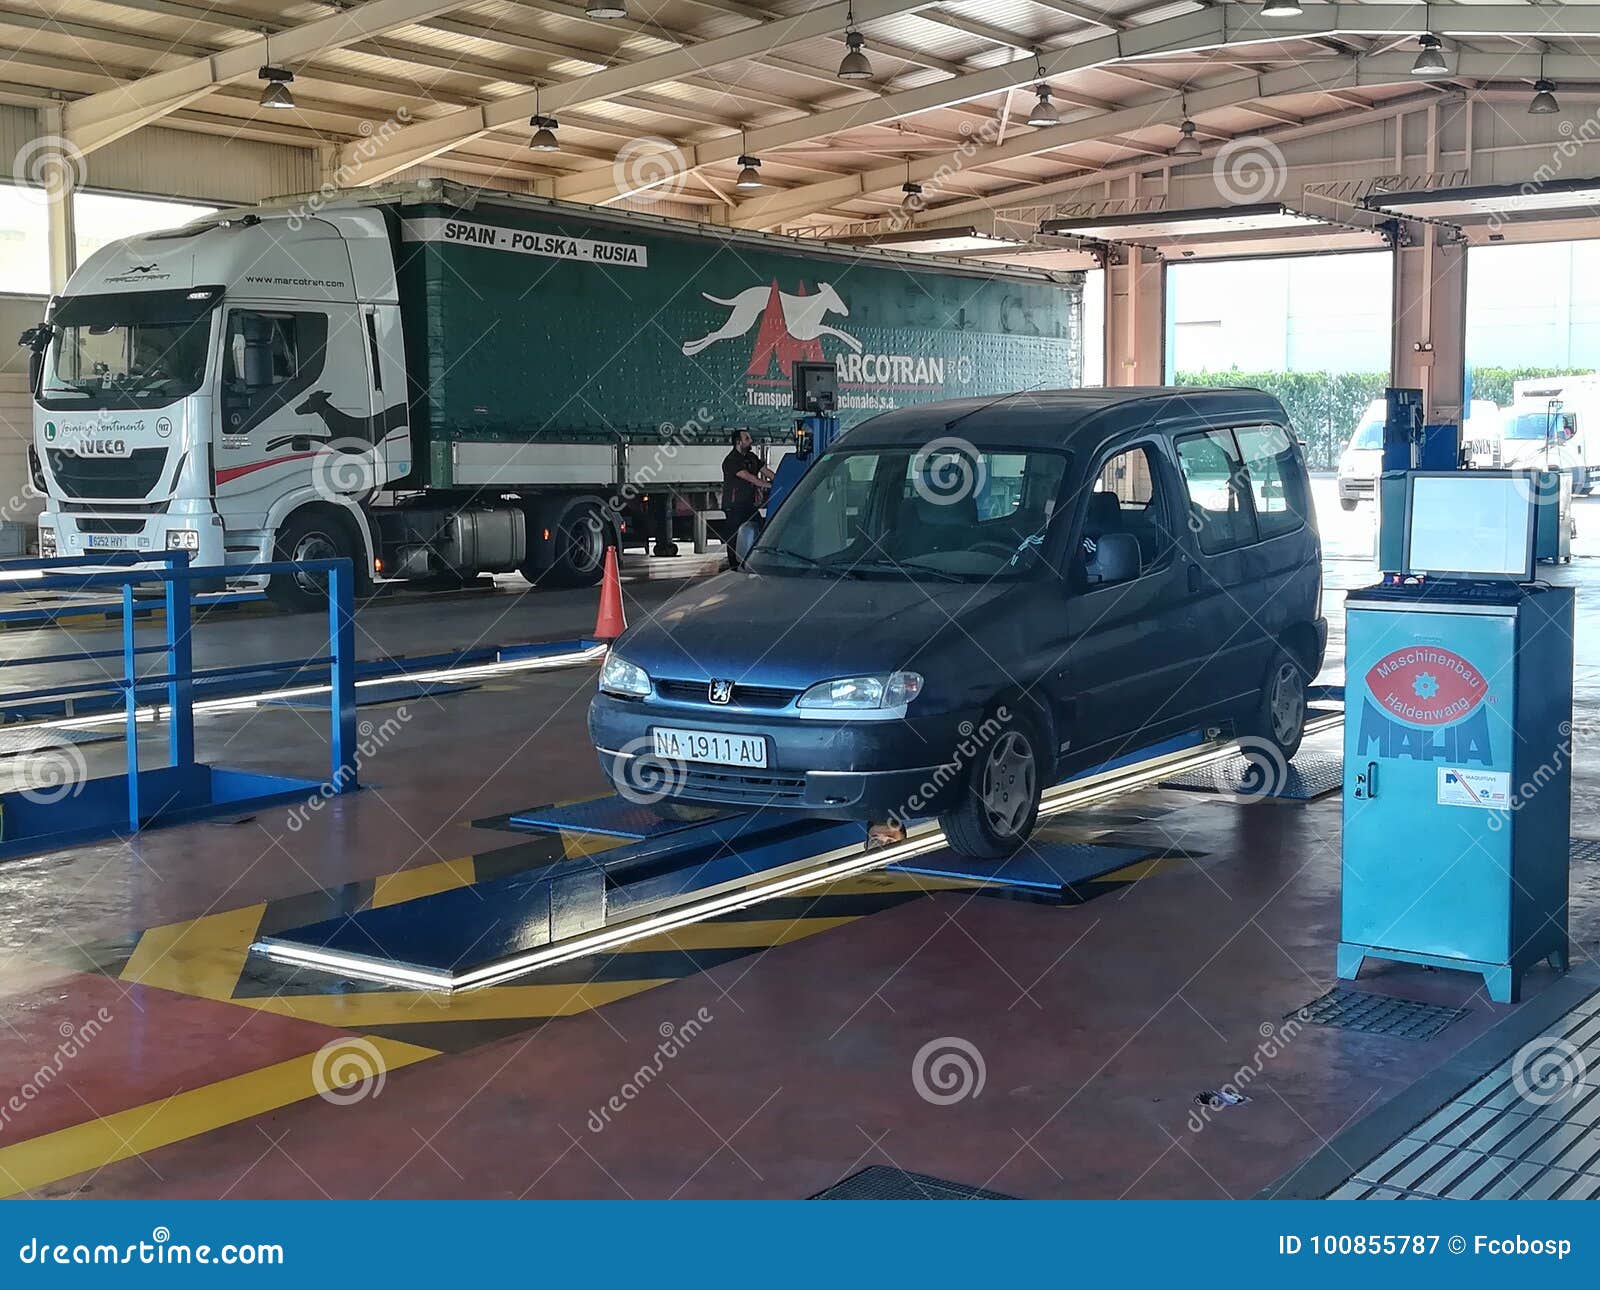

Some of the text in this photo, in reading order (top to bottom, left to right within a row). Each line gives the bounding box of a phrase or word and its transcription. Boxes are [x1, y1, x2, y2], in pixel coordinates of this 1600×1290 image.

[444, 222, 496, 245] SPAIN
[511, 232, 578, 257] POLSKA
[592, 244, 638, 263] RUSIA
[245, 275, 345, 288] www.marcotran.com
[46, 423, 54, 440] L
[96, 419, 145, 432] Continents
[80, 439, 125, 454] IVECO
[1377, 649, 1480, 689] Maschinenbau
[1385, 692, 1470, 720] Haldenwang
[1357, 695, 1493, 766] MAHA
